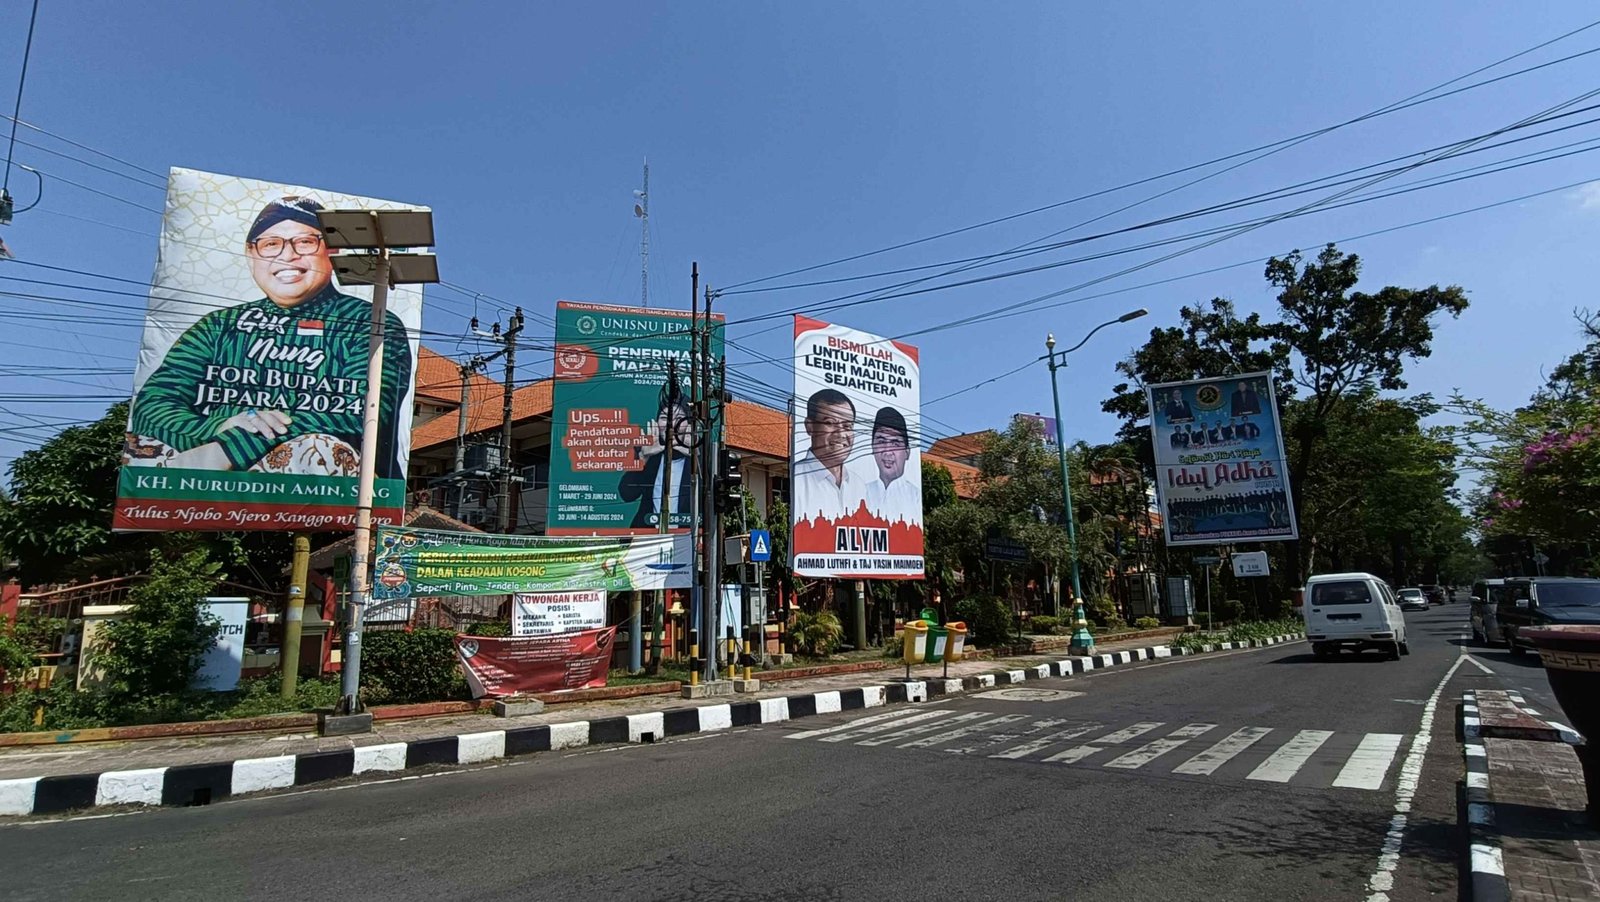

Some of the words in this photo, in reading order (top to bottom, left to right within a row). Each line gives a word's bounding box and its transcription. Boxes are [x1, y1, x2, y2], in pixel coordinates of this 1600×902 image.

[236, 307, 290, 335] Gus
[602, 317, 658, 332] UNISNU
[247, 337, 325, 370] Nung
[827, 335, 893, 361] BISMILLAH
[812, 344, 860, 365] UNTUK
[862, 356, 906, 376] JATENG
[205, 365, 258, 385] FOR
[265, 368, 359, 395] BUPATI
[805, 355, 846, 373] LEBIH
[850, 365, 885, 382] MAJU
[888, 374, 912, 389] DAN
[824, 372, 898, 397] SEJAHTERA
[193, 384, 289, 409] JEPARA
[296, 393, 362, 415] 2024
[567, 437, 592, 447] akan
[594, 436, 631, 448] ditutup
[570, 427, 632, 438] Pendaftaran
[576, 450, 596, 460] yuk
[597, 449, 629, 458] daftar
[136, 475, 173, 489] KH.
[180, 478, 285, 494] NURUDDIN
[291, 483, 345, 498] AMIN,
[123, 505, 170, 519] Tulus
[172, 507, 222, 524] Njobo
[225, 509, 270, 525] Njero
[273, 512, 333, 527] Kanggo
[836, 526, 889, 553] ALYM
[416, 566, 454, 579] DALAM
[456, 565, 504, 578] KEADAAN
[506, 565, 547, 578] KOSONG
[797, 558, 826, 569] AHMAD
[827, 558, 851, 569] LUTHFI
[852, 559, 858, 569] &
[859, 559, 872, 569] TAJ
[873, 559, 892, 569] YASIN
[415, 583, 452, 595] Seperti
[520, 595, 570, 605] LOWONGAN
[573, 593, 600, 603] KERJA
